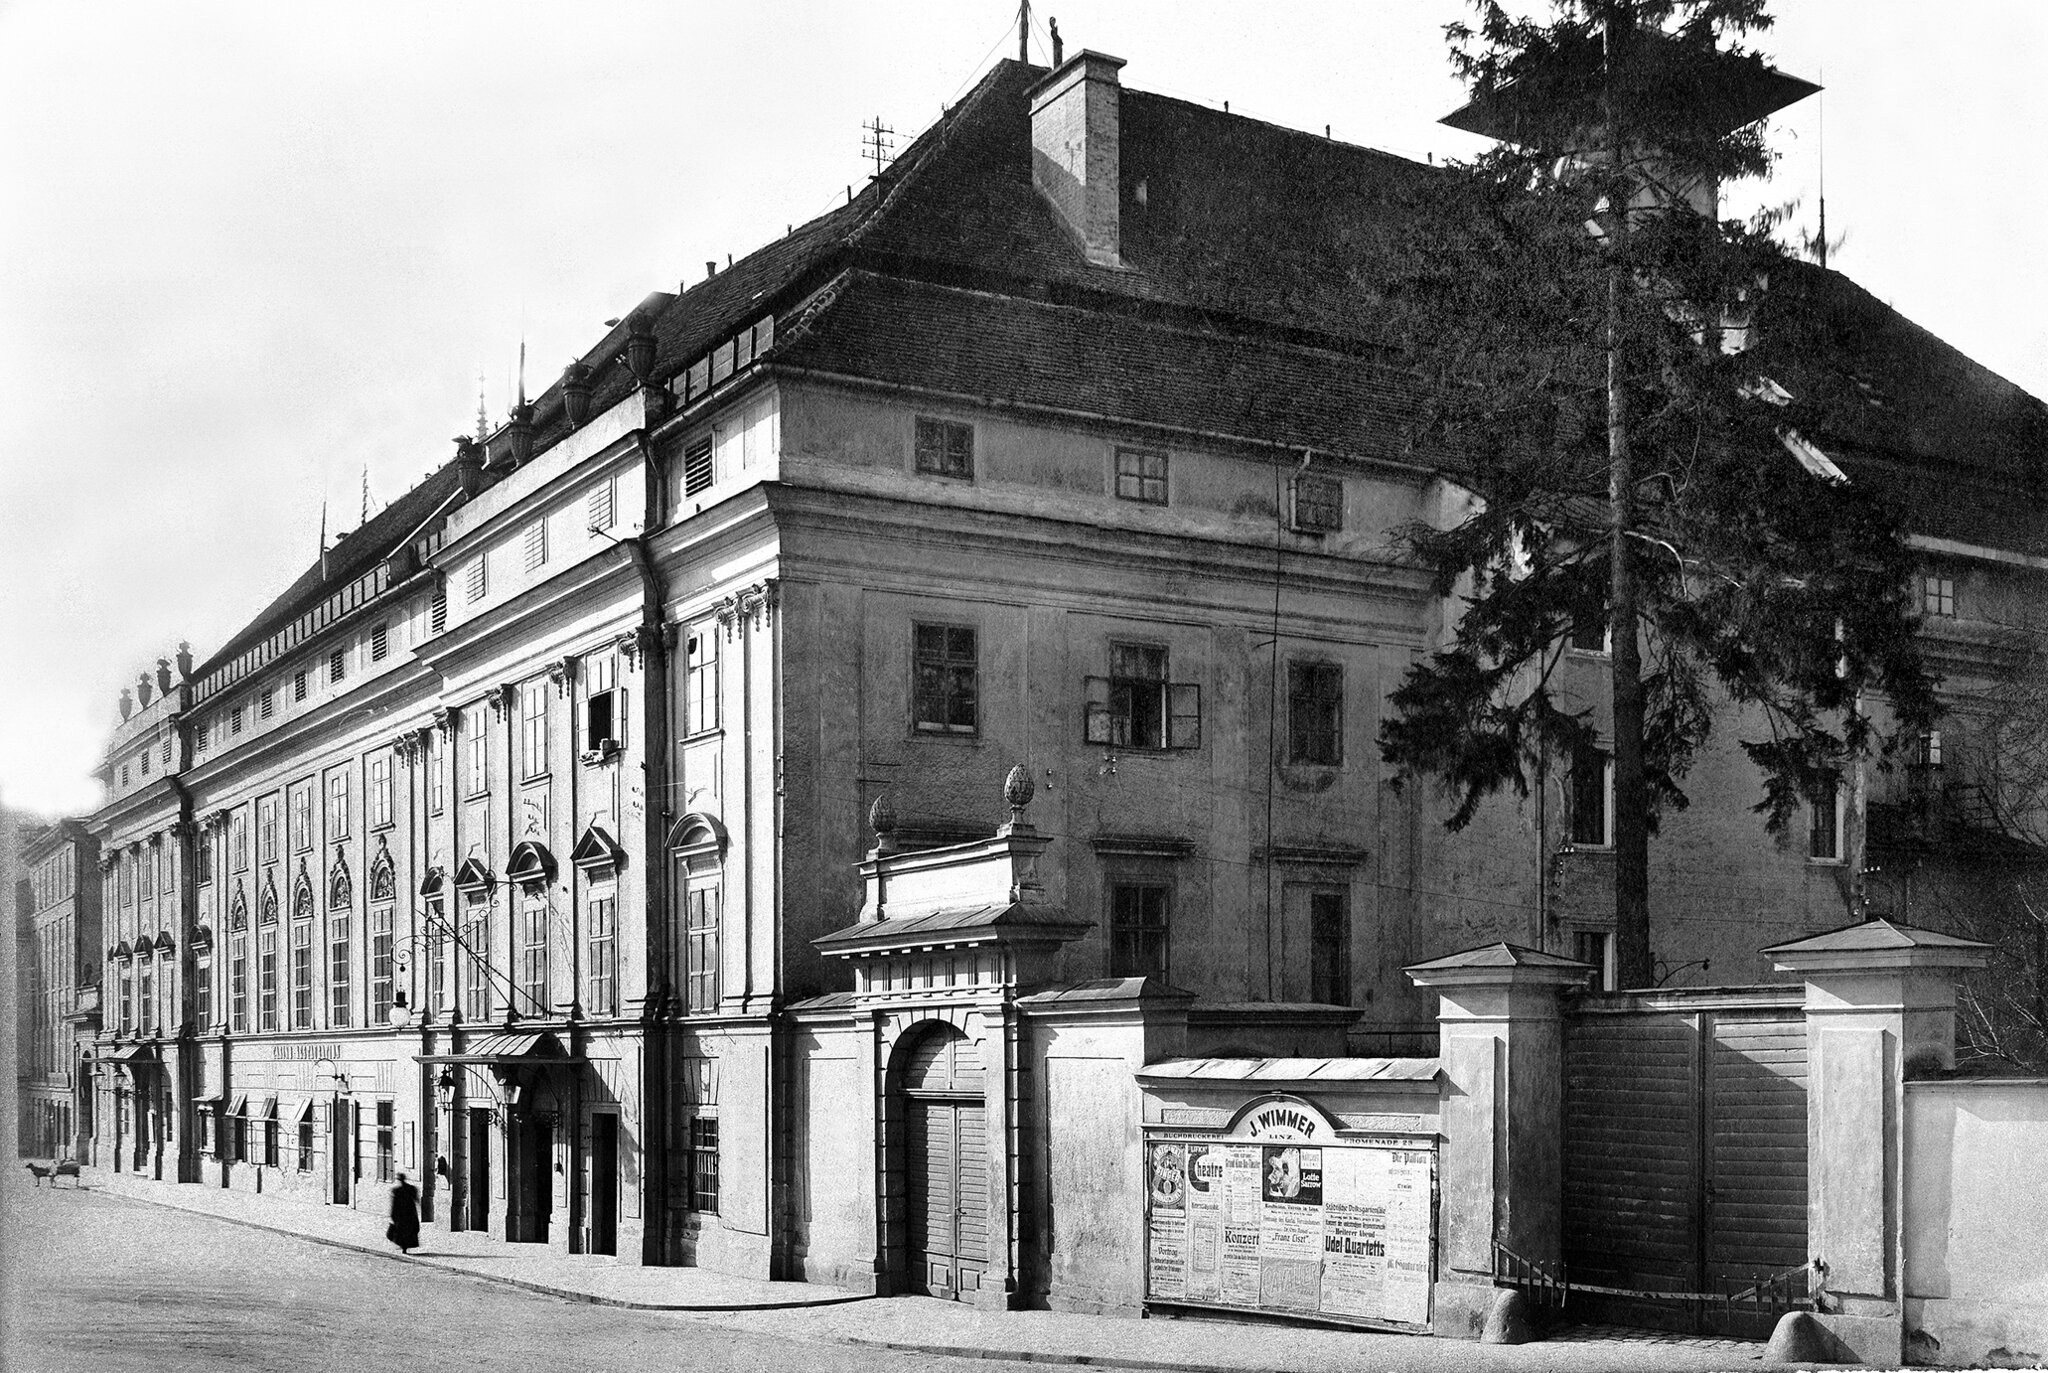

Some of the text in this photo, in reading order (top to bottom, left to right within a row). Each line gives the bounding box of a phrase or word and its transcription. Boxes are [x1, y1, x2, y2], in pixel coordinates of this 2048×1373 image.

[1249, 1109, 1316, 1139] J. WIMMER
[1344, 1138, 1399, 1146] PROMENADE
[1225, 1230, 1260, 1245] Konzert
